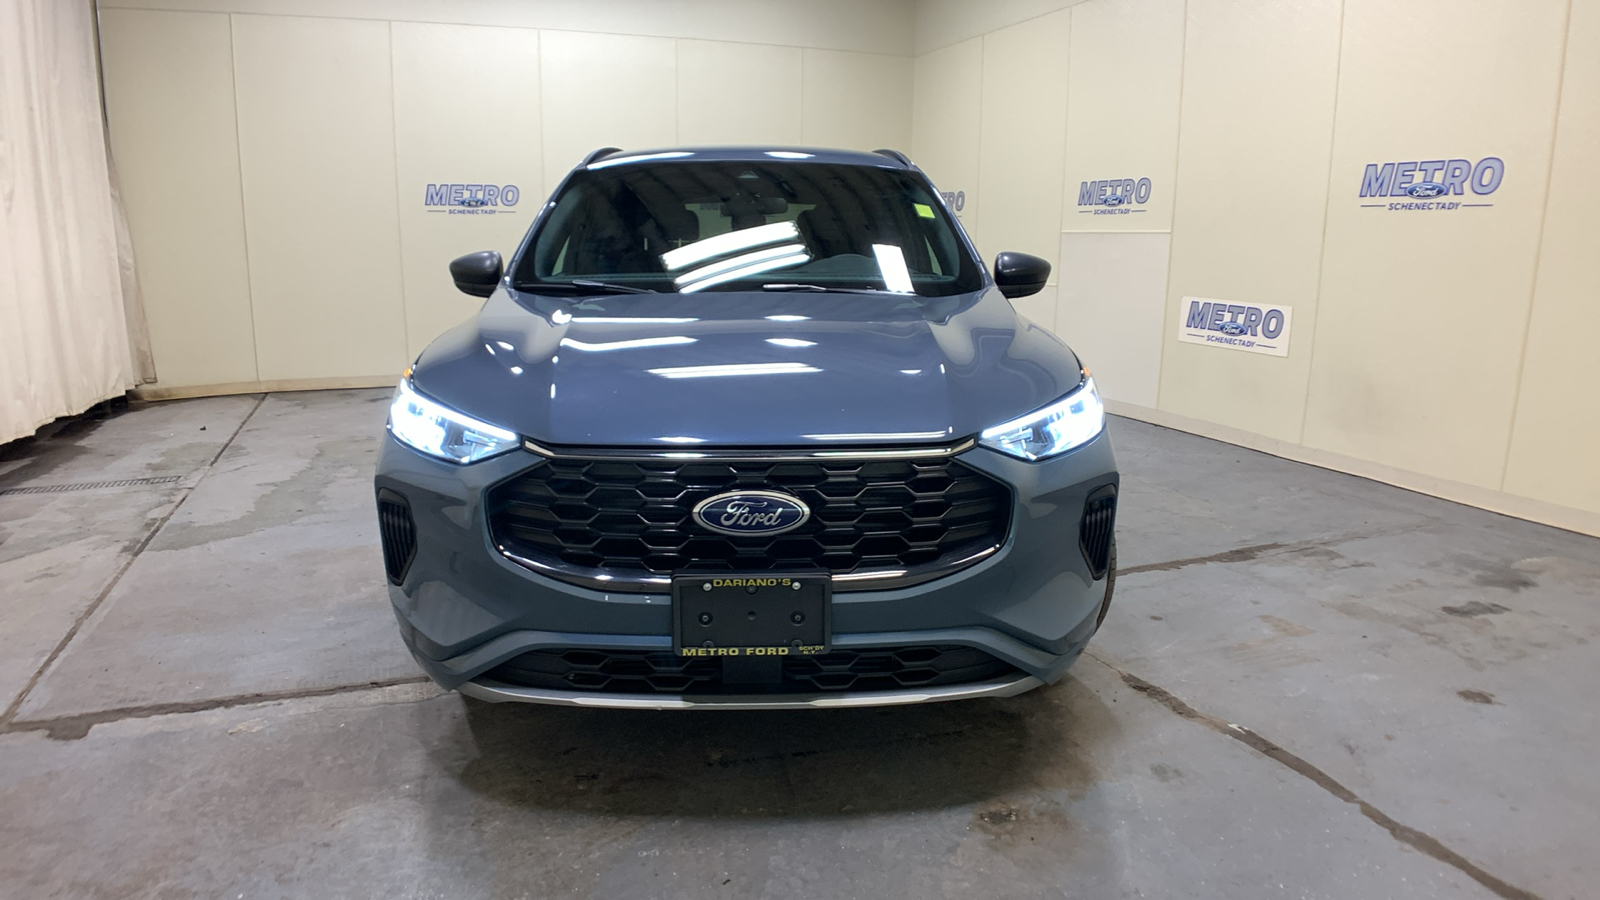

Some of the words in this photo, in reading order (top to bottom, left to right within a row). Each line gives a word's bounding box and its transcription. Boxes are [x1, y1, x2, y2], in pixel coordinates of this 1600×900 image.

[1359, 157, 1505, 197] METRO
[424, 184, 520, 206] METRO
[1077, 177, 1152, 206] METRO
[1412, 185, 1439, 196] Ford
[1388, 202, 1461, 211] SCHENECTADY
[1186, 301, 1284, 339] METRO
[1206, 335, 1256, 347] SCHENECTADY
[720, 500, 784, 527] Ford
[713, 578, 791, 587] DARIANO'S
[682, 647, 739, 656] METRO
[746, 647, 789, 656] FORD
